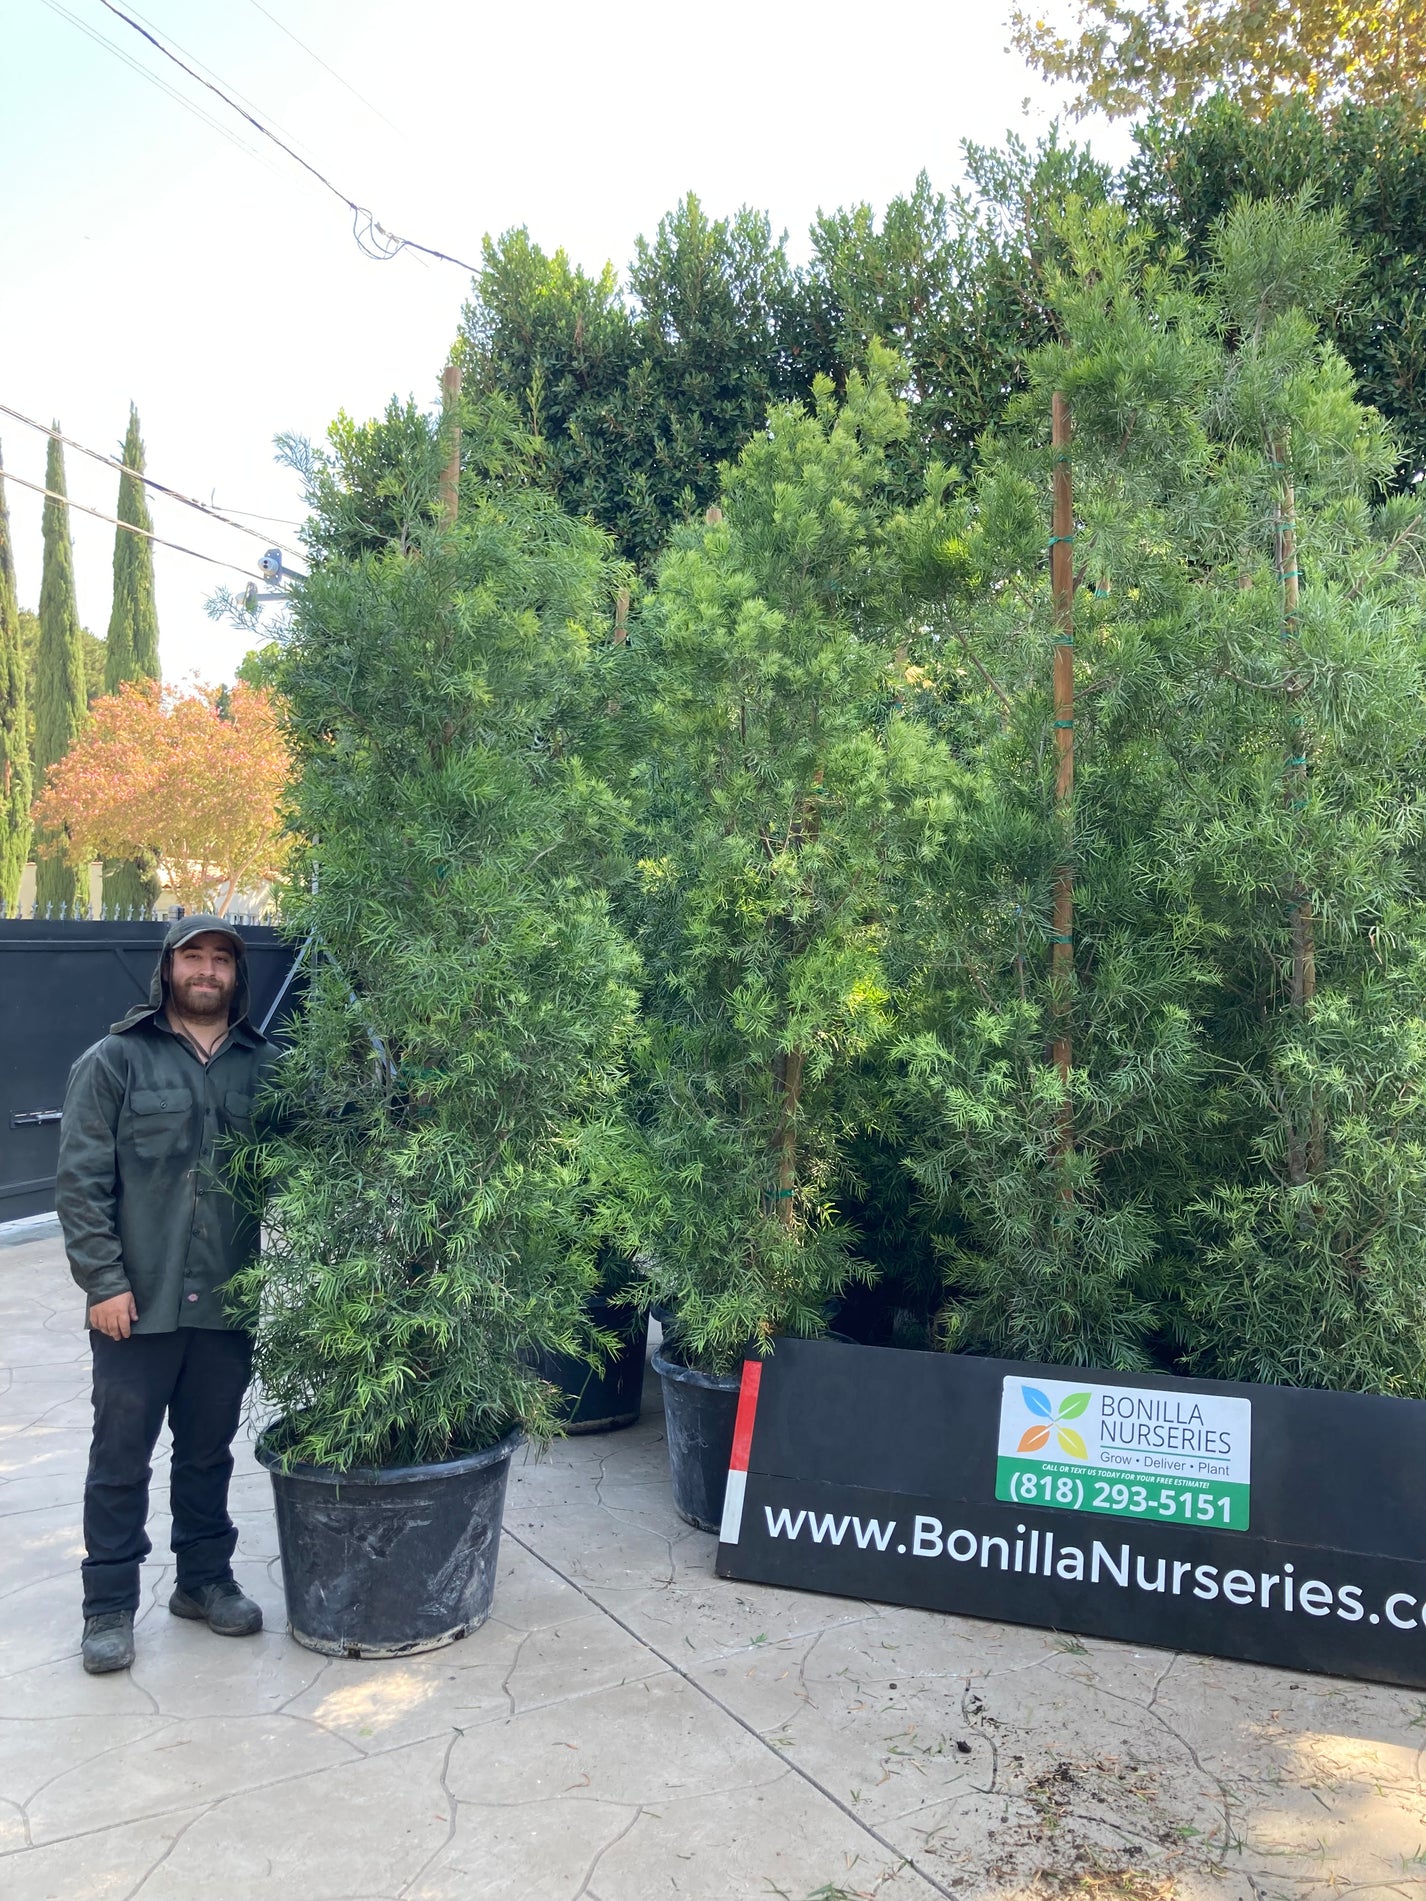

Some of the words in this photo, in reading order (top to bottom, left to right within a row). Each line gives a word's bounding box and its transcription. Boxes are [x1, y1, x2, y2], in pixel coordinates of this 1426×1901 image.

[1101, 1394, 1204, 1426] BONILLA
[1100, 1419, 1232, 1455] NURSERIES
[1042, 1463, 1058, 1472] CALL
[1059, 1465, 1069, 1473] OR
[1070, 1466, 1087, 1475] TEXT
[1087, 1468, 1096, 1476] US
[1098, 1469, 1120, 1479] TODAY
[1121, 1472, 1135, 1481] FOR
[1136, 1474, 1155, 1483] YOUR
[1156, 1476, 1173, 1485] FREE
[1174, 1478, 1210, 1489] ESTIMATE!
[1100, 1451, 1132, 1465] Grow
[1144, 1456, 1186, 1471] Deliver
[1198, 1461, 1230, 1476] Plant
[1010, 1471, 1084, 1509] (818)
[1092, 1481, 1232, 1523] 293-5151
[764, 1505, 1426, 1629] www.BonillaNurseries.c
